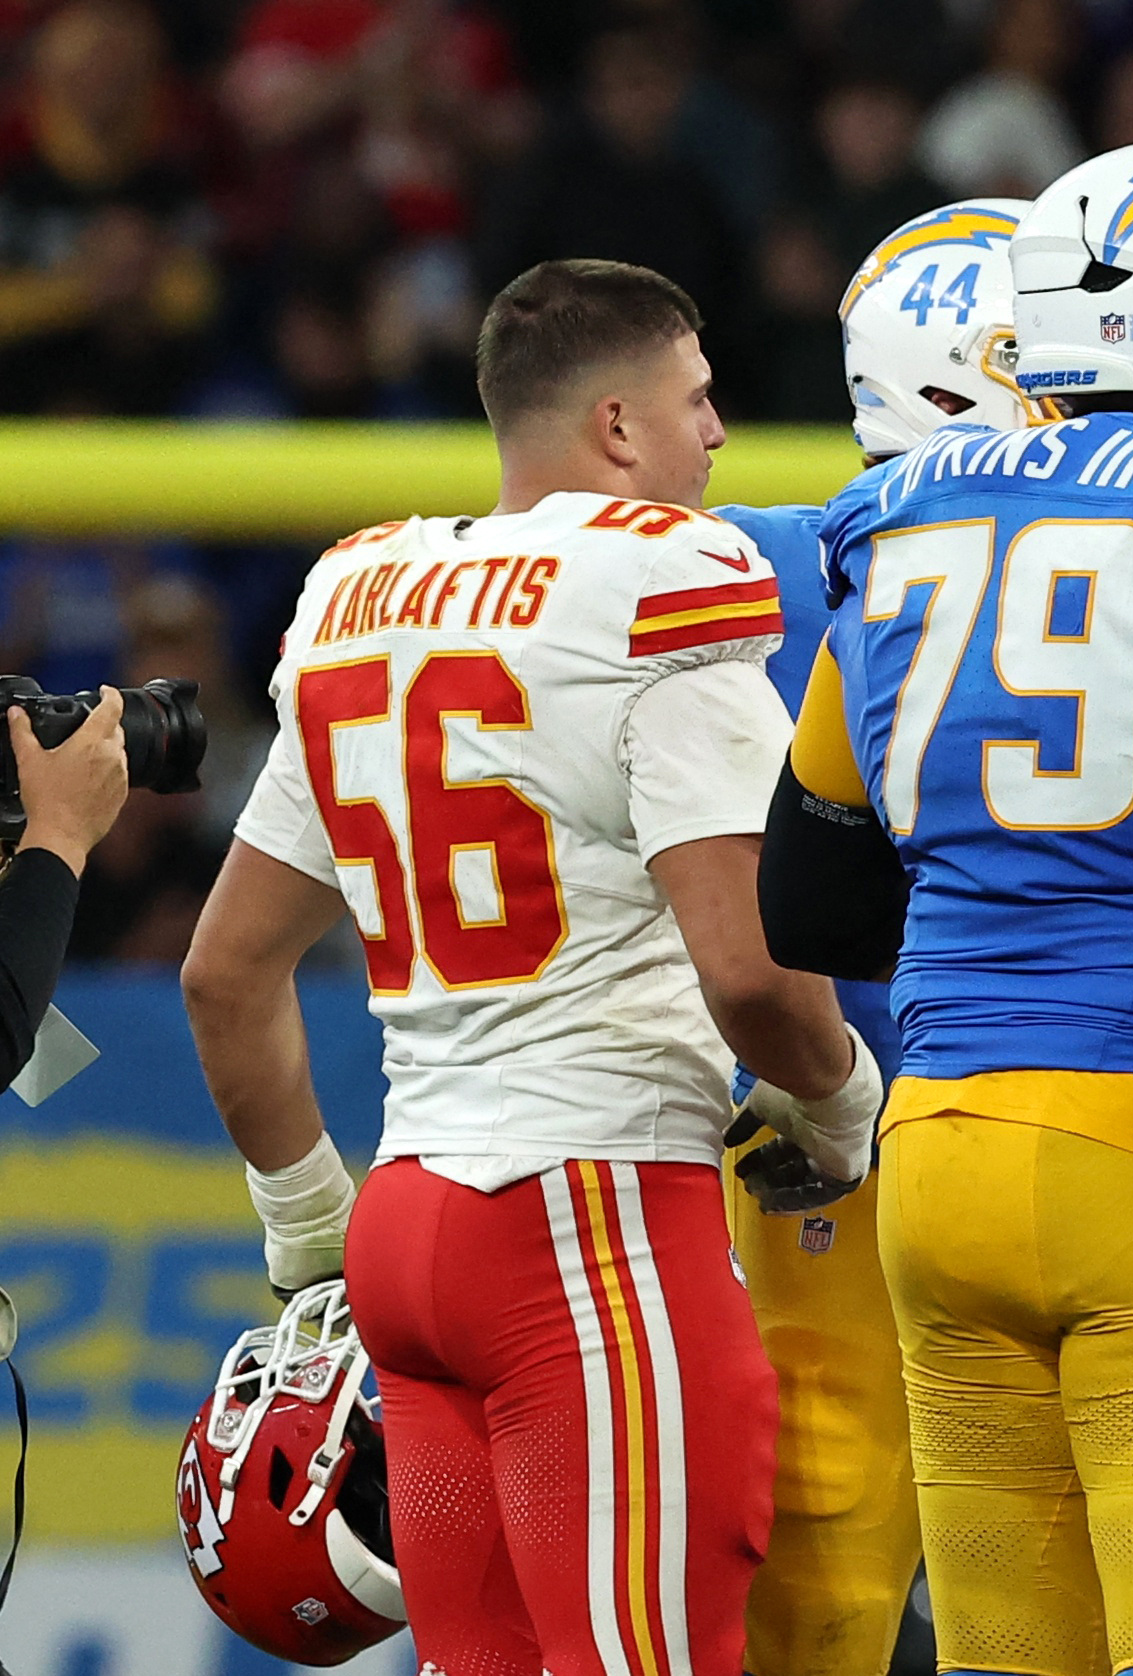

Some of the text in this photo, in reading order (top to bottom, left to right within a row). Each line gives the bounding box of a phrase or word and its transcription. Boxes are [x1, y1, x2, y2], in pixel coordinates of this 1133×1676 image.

[900, 263, 981, 326] 44
[1103, 326, 1124, 340] NFL
[312, 555, 561, 647] KARLAFTIS
[294, 650, 570, 998] 56
